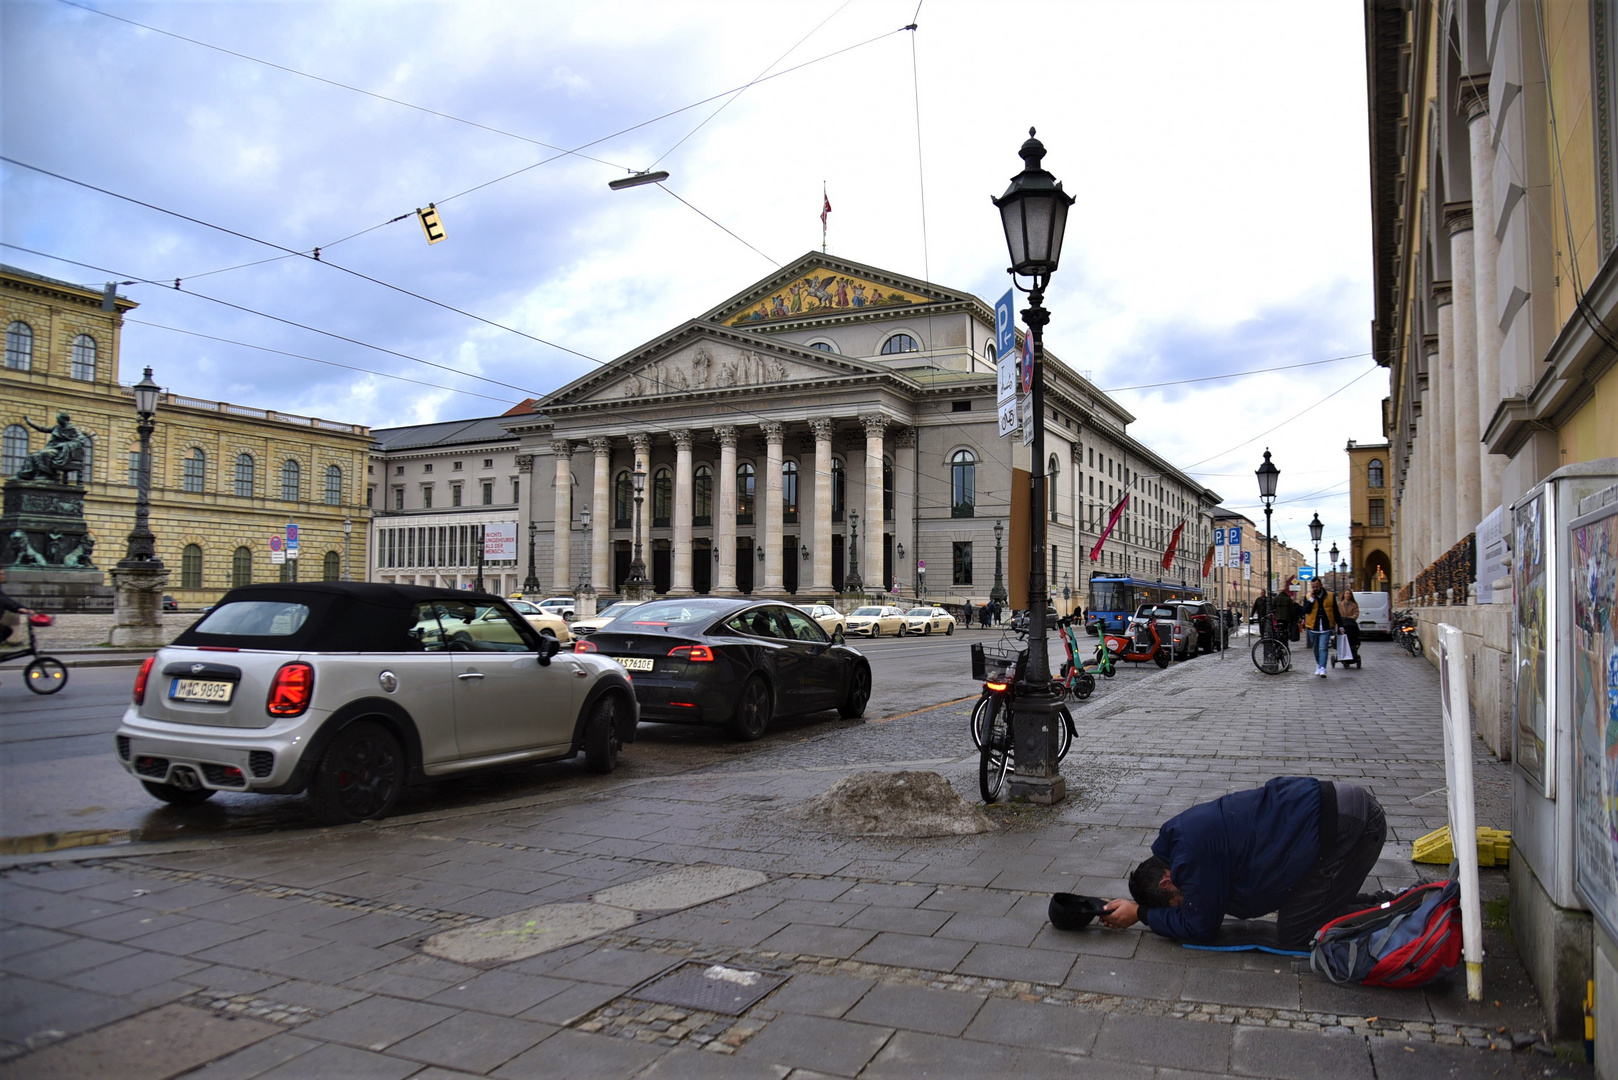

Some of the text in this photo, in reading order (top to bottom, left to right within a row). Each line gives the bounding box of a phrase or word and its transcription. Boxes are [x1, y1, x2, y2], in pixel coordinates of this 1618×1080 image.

[421, 210, 443, 241] E
[998, 303, 1008, 351] P
[1216, 531, 1222, 544] P
[1231, 530, 1237, 543] P
